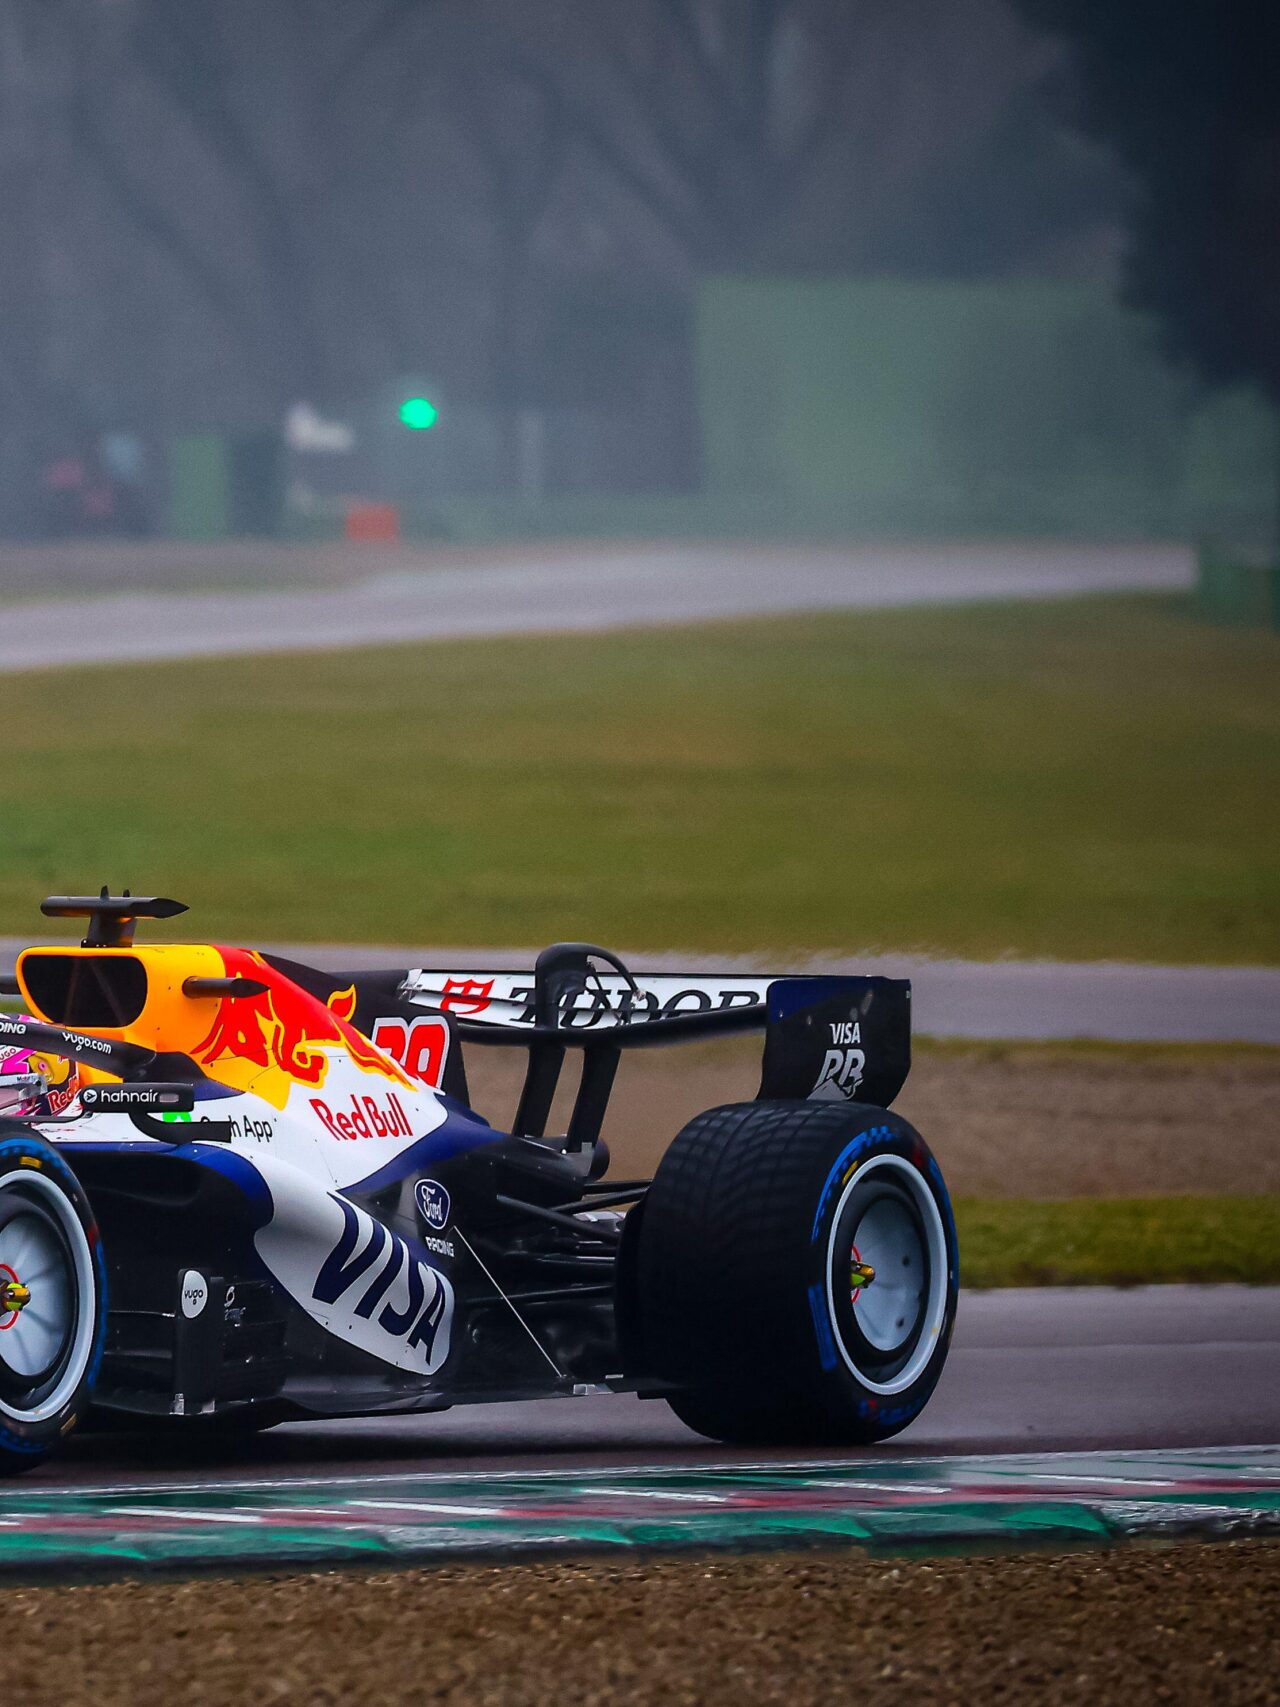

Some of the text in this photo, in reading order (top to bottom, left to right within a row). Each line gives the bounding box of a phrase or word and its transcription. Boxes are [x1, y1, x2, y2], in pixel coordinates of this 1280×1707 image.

[61, 1031, 112, 1055] yugo.com
[828, 1022, 862, 1045] VISA
[101, 1089, 158, 1103] hahnair
[242, 1115, 273, 1142] App
[308, 1092, 413, 1141] Red Bull
[425, 1236, 455, 1257] RACING
[312, 1191, 446, 1366] VISA
